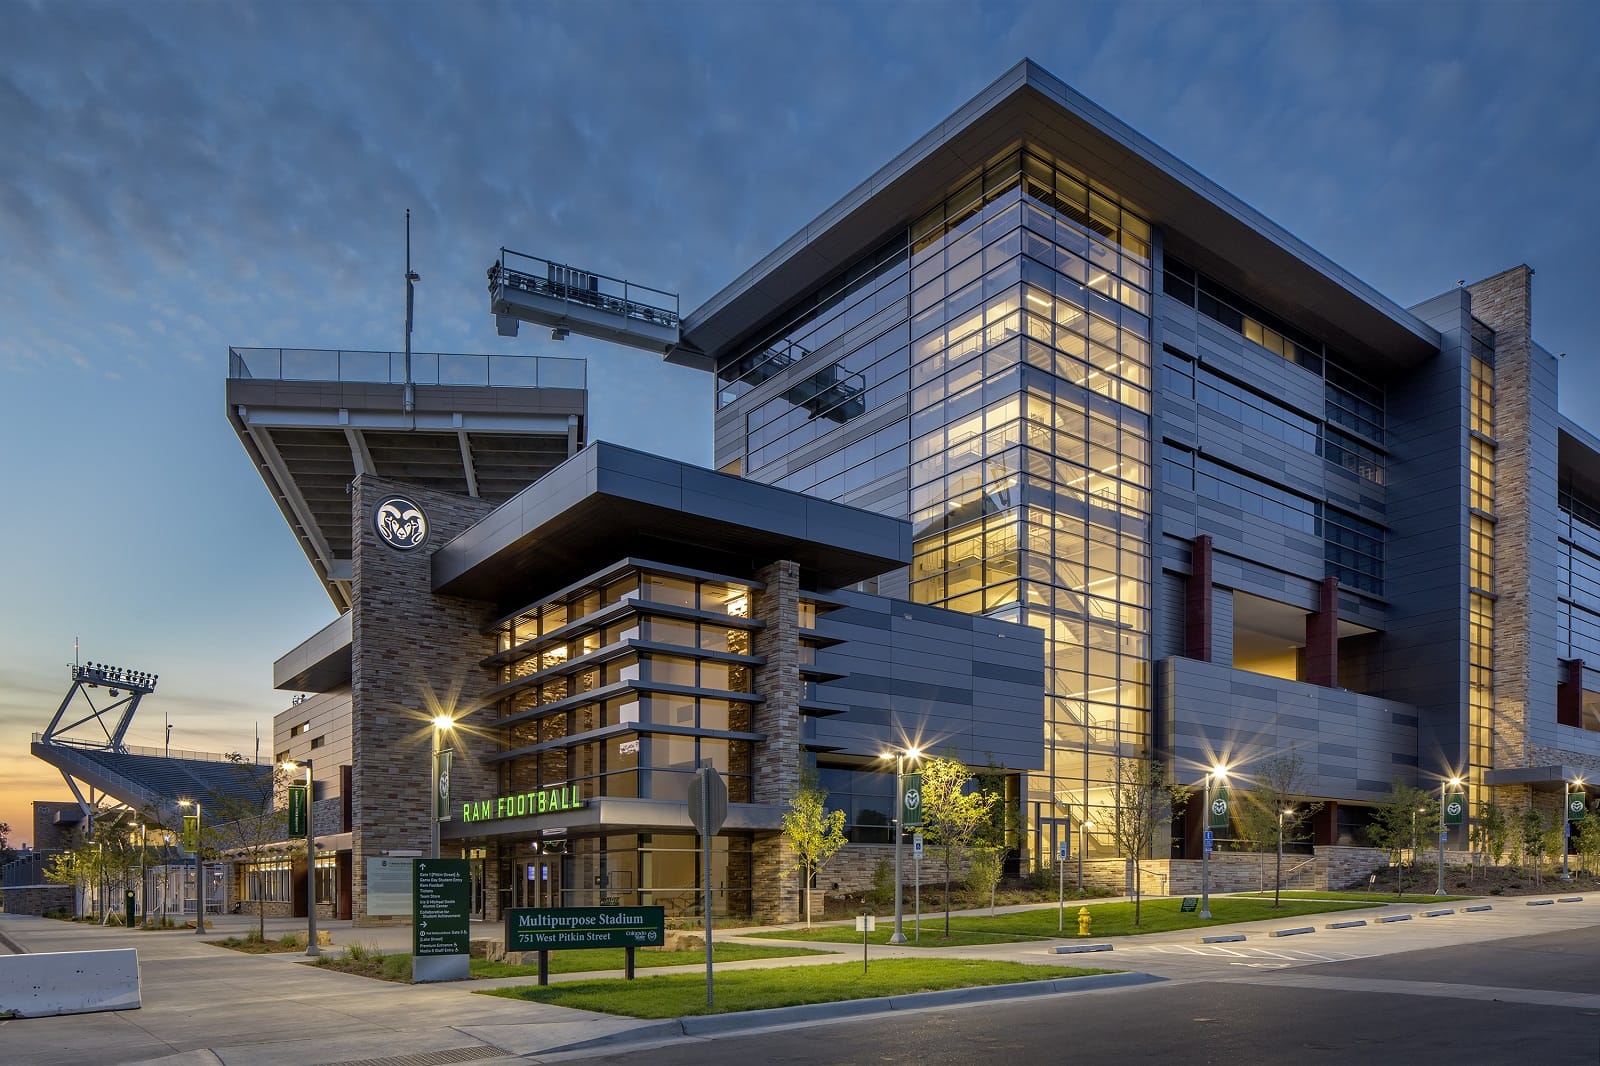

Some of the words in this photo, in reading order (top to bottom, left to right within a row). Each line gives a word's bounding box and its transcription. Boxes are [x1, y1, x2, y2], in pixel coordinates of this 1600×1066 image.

[463, 800, 490, 822] RAM
[498, 785, 580, 818] FOOTBALL
[519, 914, 596, 928] Multipurpose
[600, 913, 644, 924] Stadium
[519, 934, 534, 943] 751
[536, 933, 556, 942] West
[558, 932, 585, 941] Pitkin
[587, 932, 611, 941] Street
